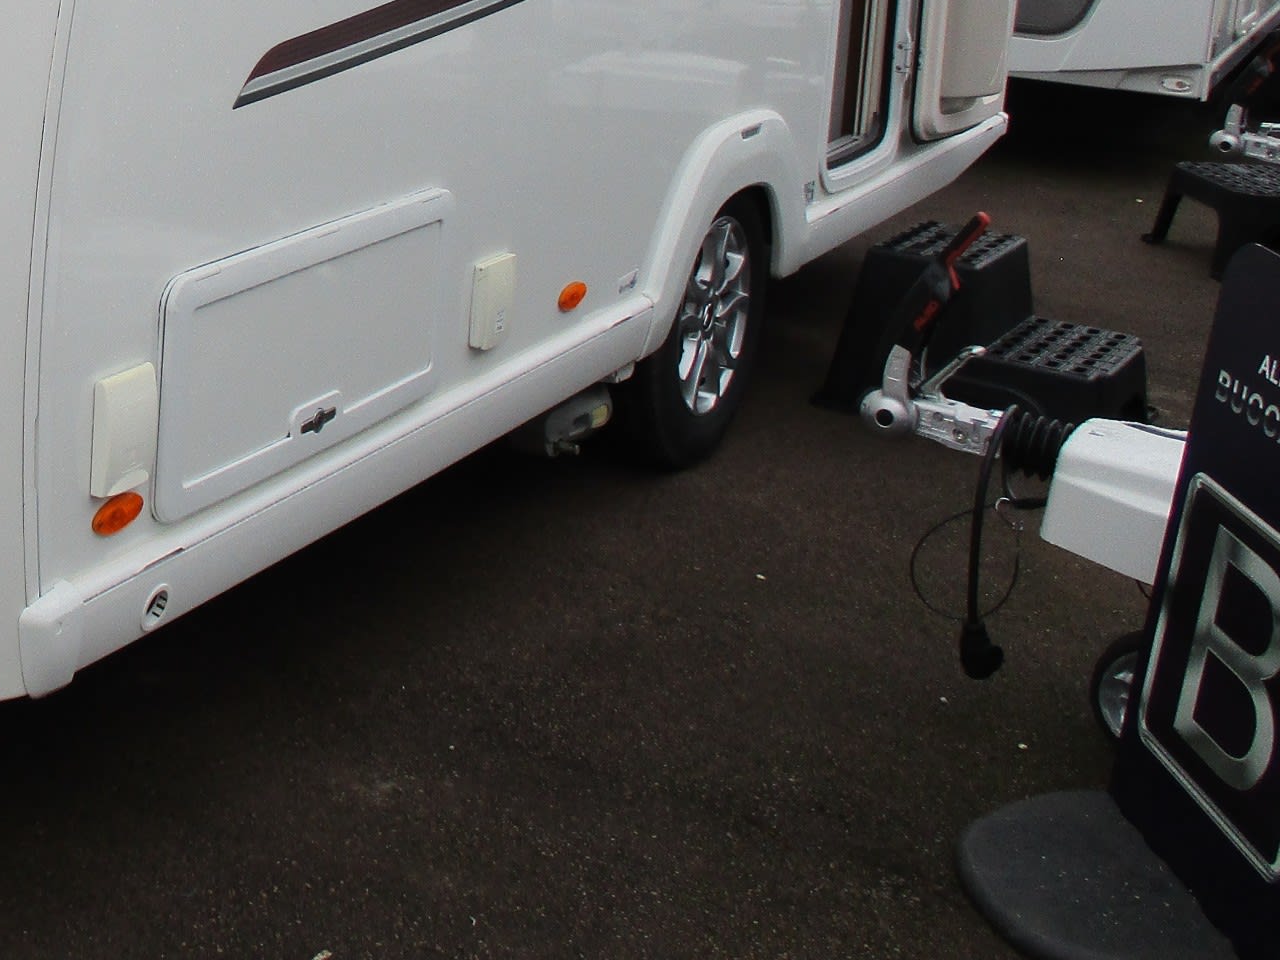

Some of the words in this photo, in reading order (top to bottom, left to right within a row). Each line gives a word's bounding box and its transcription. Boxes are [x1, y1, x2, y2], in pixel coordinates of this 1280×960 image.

[1215, 369, 1280, 445] BUCC
[1257, 353, 1280, 388] AL
[1173, 523, 1280, 791] B
